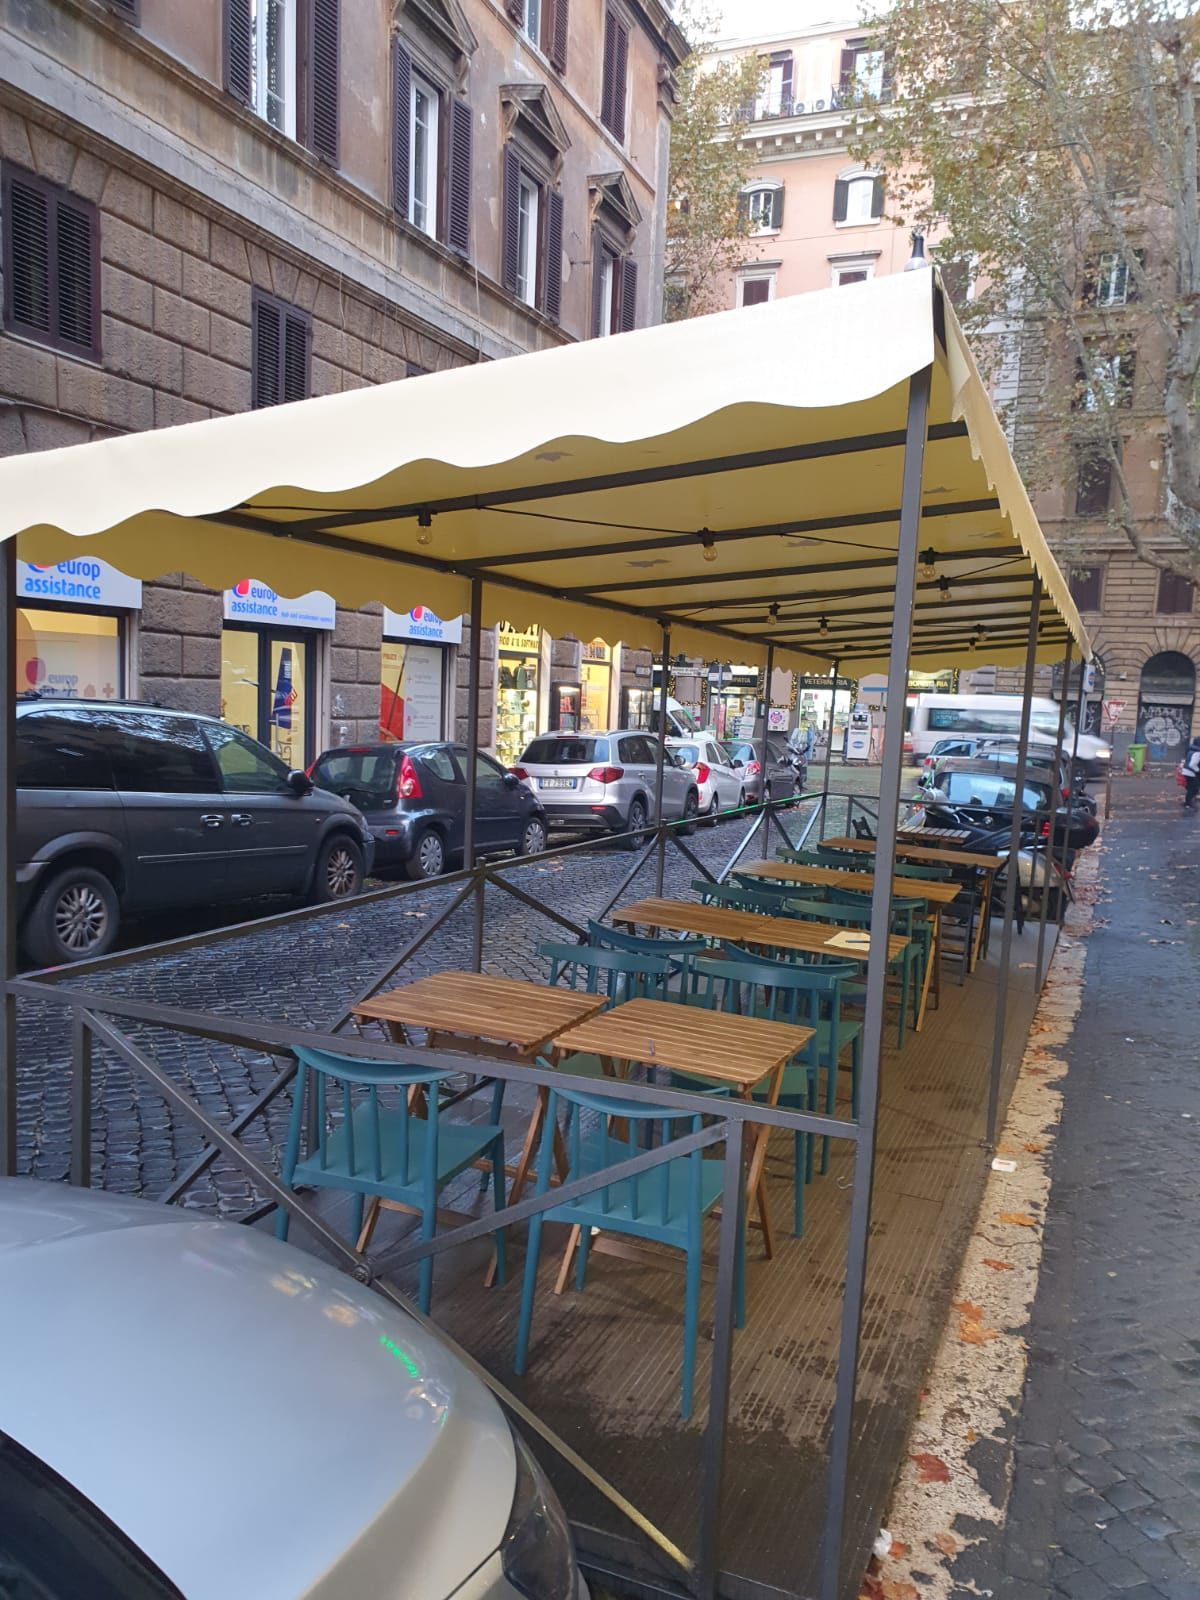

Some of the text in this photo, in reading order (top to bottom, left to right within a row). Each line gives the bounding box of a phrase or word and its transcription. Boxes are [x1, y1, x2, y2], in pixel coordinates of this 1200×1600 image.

[57, 560, 100, 581] europ
[24, 576, 101, 599] assistance
[251, 587, 278, 602] europ
[231, 599, 278, 616] assistance
[409, 623, 443, 638] assistance
[803, 678, 848, 686] VETERINRIA
